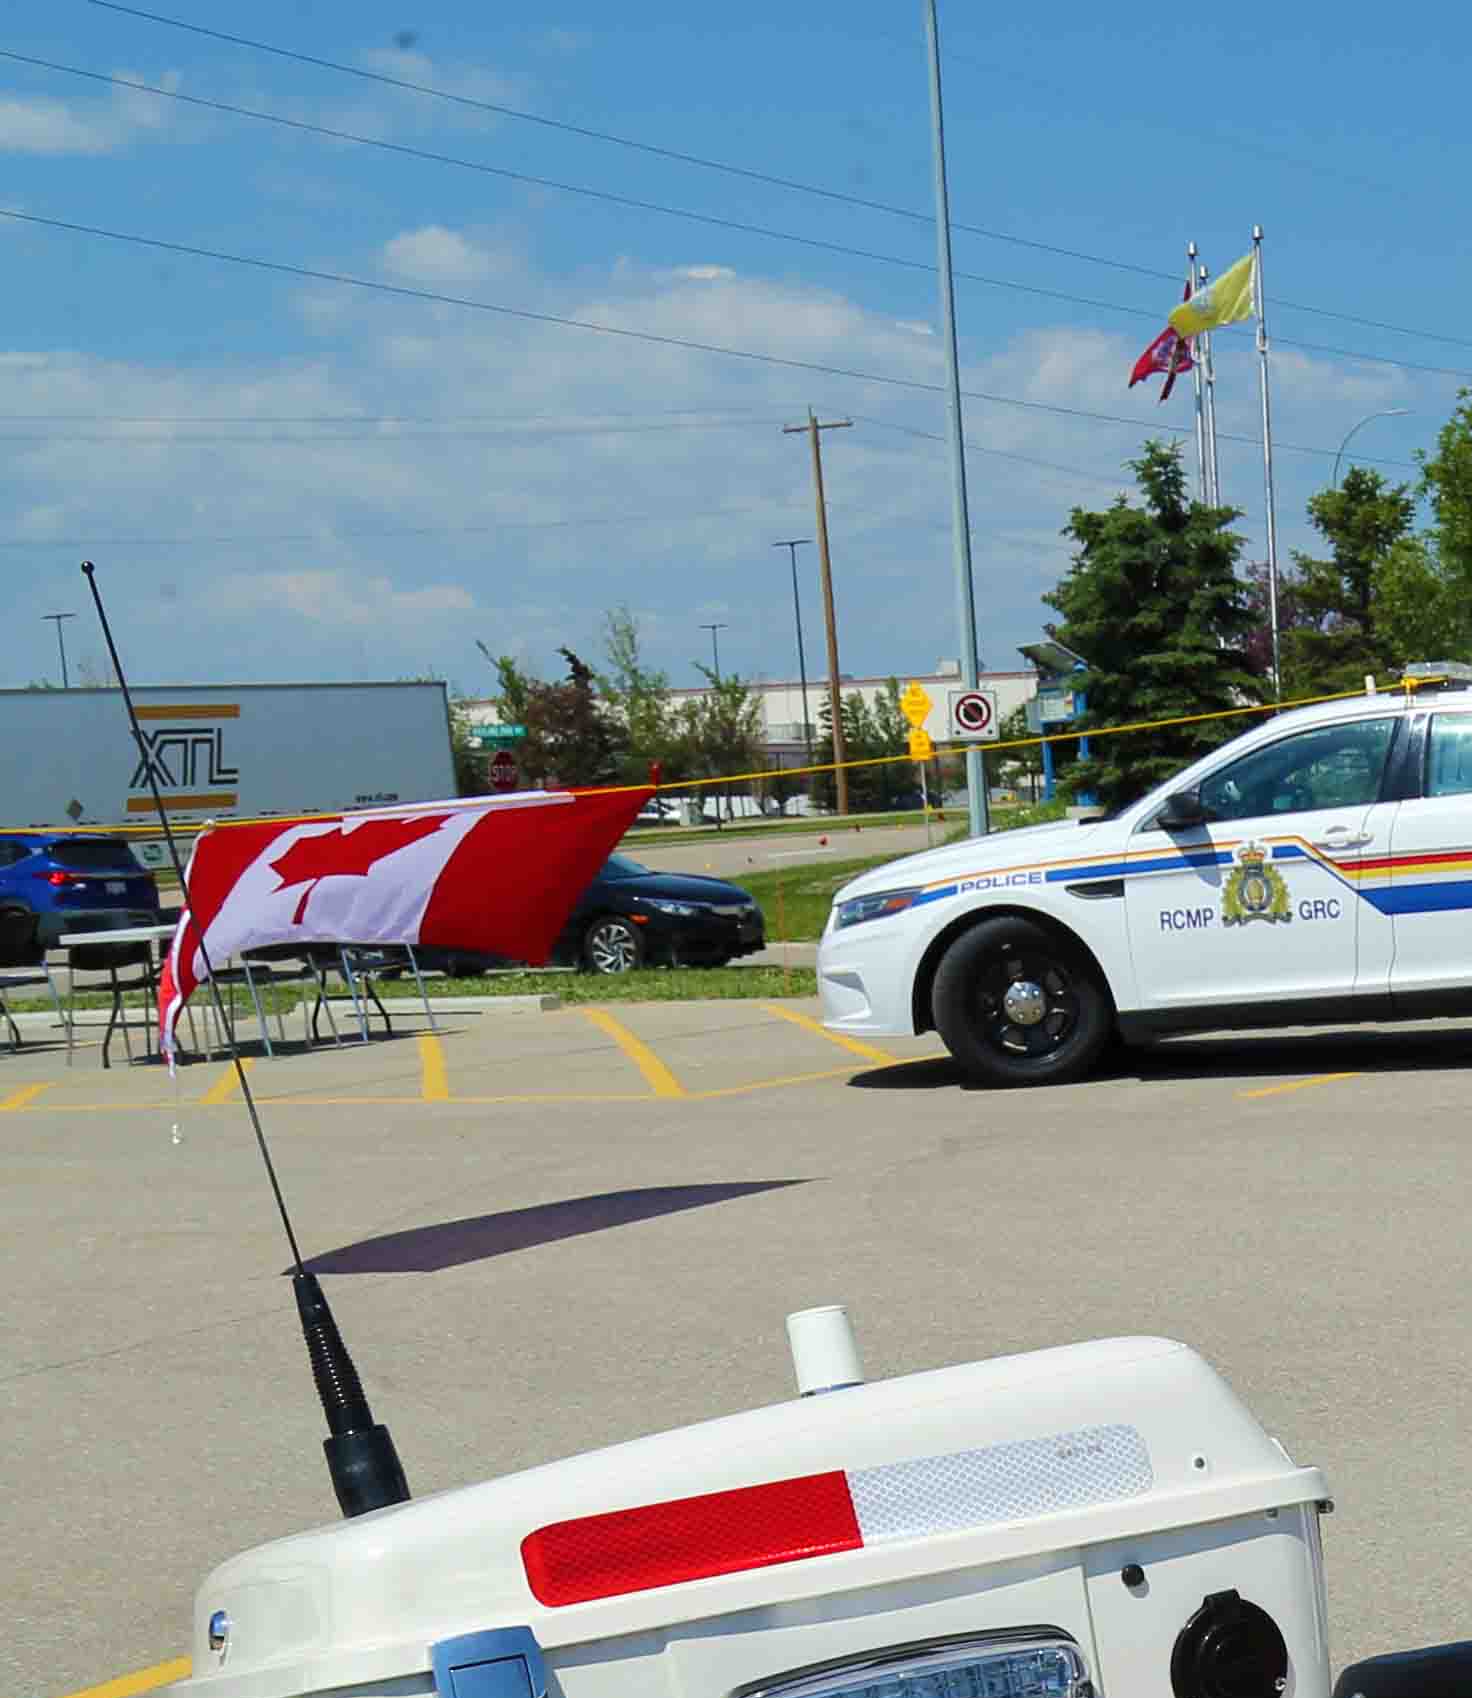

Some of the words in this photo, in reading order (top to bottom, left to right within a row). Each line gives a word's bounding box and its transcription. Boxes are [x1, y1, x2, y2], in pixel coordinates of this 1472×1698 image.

[129, 727, 239, 788] XTL
[960, 871, 1042, 893] POLICE
[1160, 907, 1214, 931] RCMP
[1299, 898, 1341, 921] GRC
